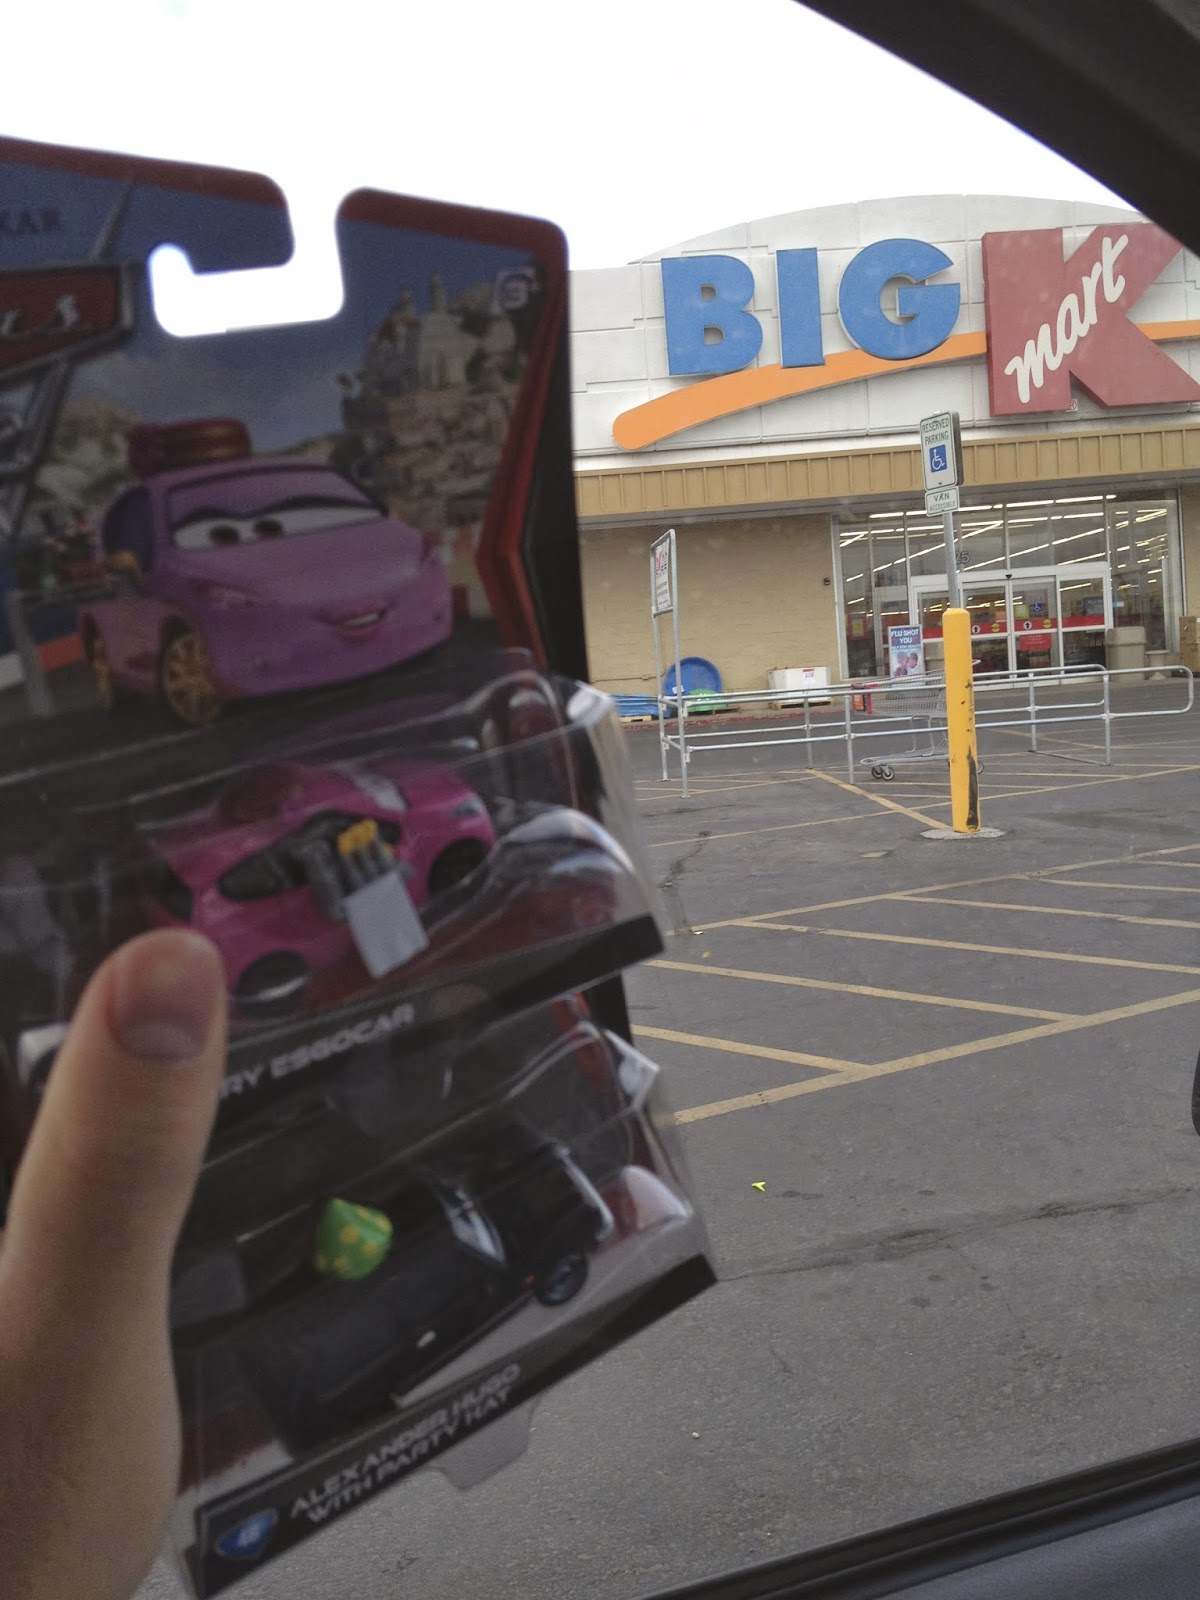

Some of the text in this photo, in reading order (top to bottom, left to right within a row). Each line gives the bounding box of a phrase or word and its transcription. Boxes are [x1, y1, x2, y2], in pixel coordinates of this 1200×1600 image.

[661, 238, 960, 376] BIG
[1004, 234, 1129, 404] mart
[922, 417, 950, 433] RESERVED
[924, 431, 949, 446] PARKING
[929, 500, 956, 512] ACCESSIBLE
[933, 492, 950, 502] VAN
[290, 1362, 521, 1519] ALEXANDER HUGO
[306, 1384, 513, 1522] WITH PARTY HAT
